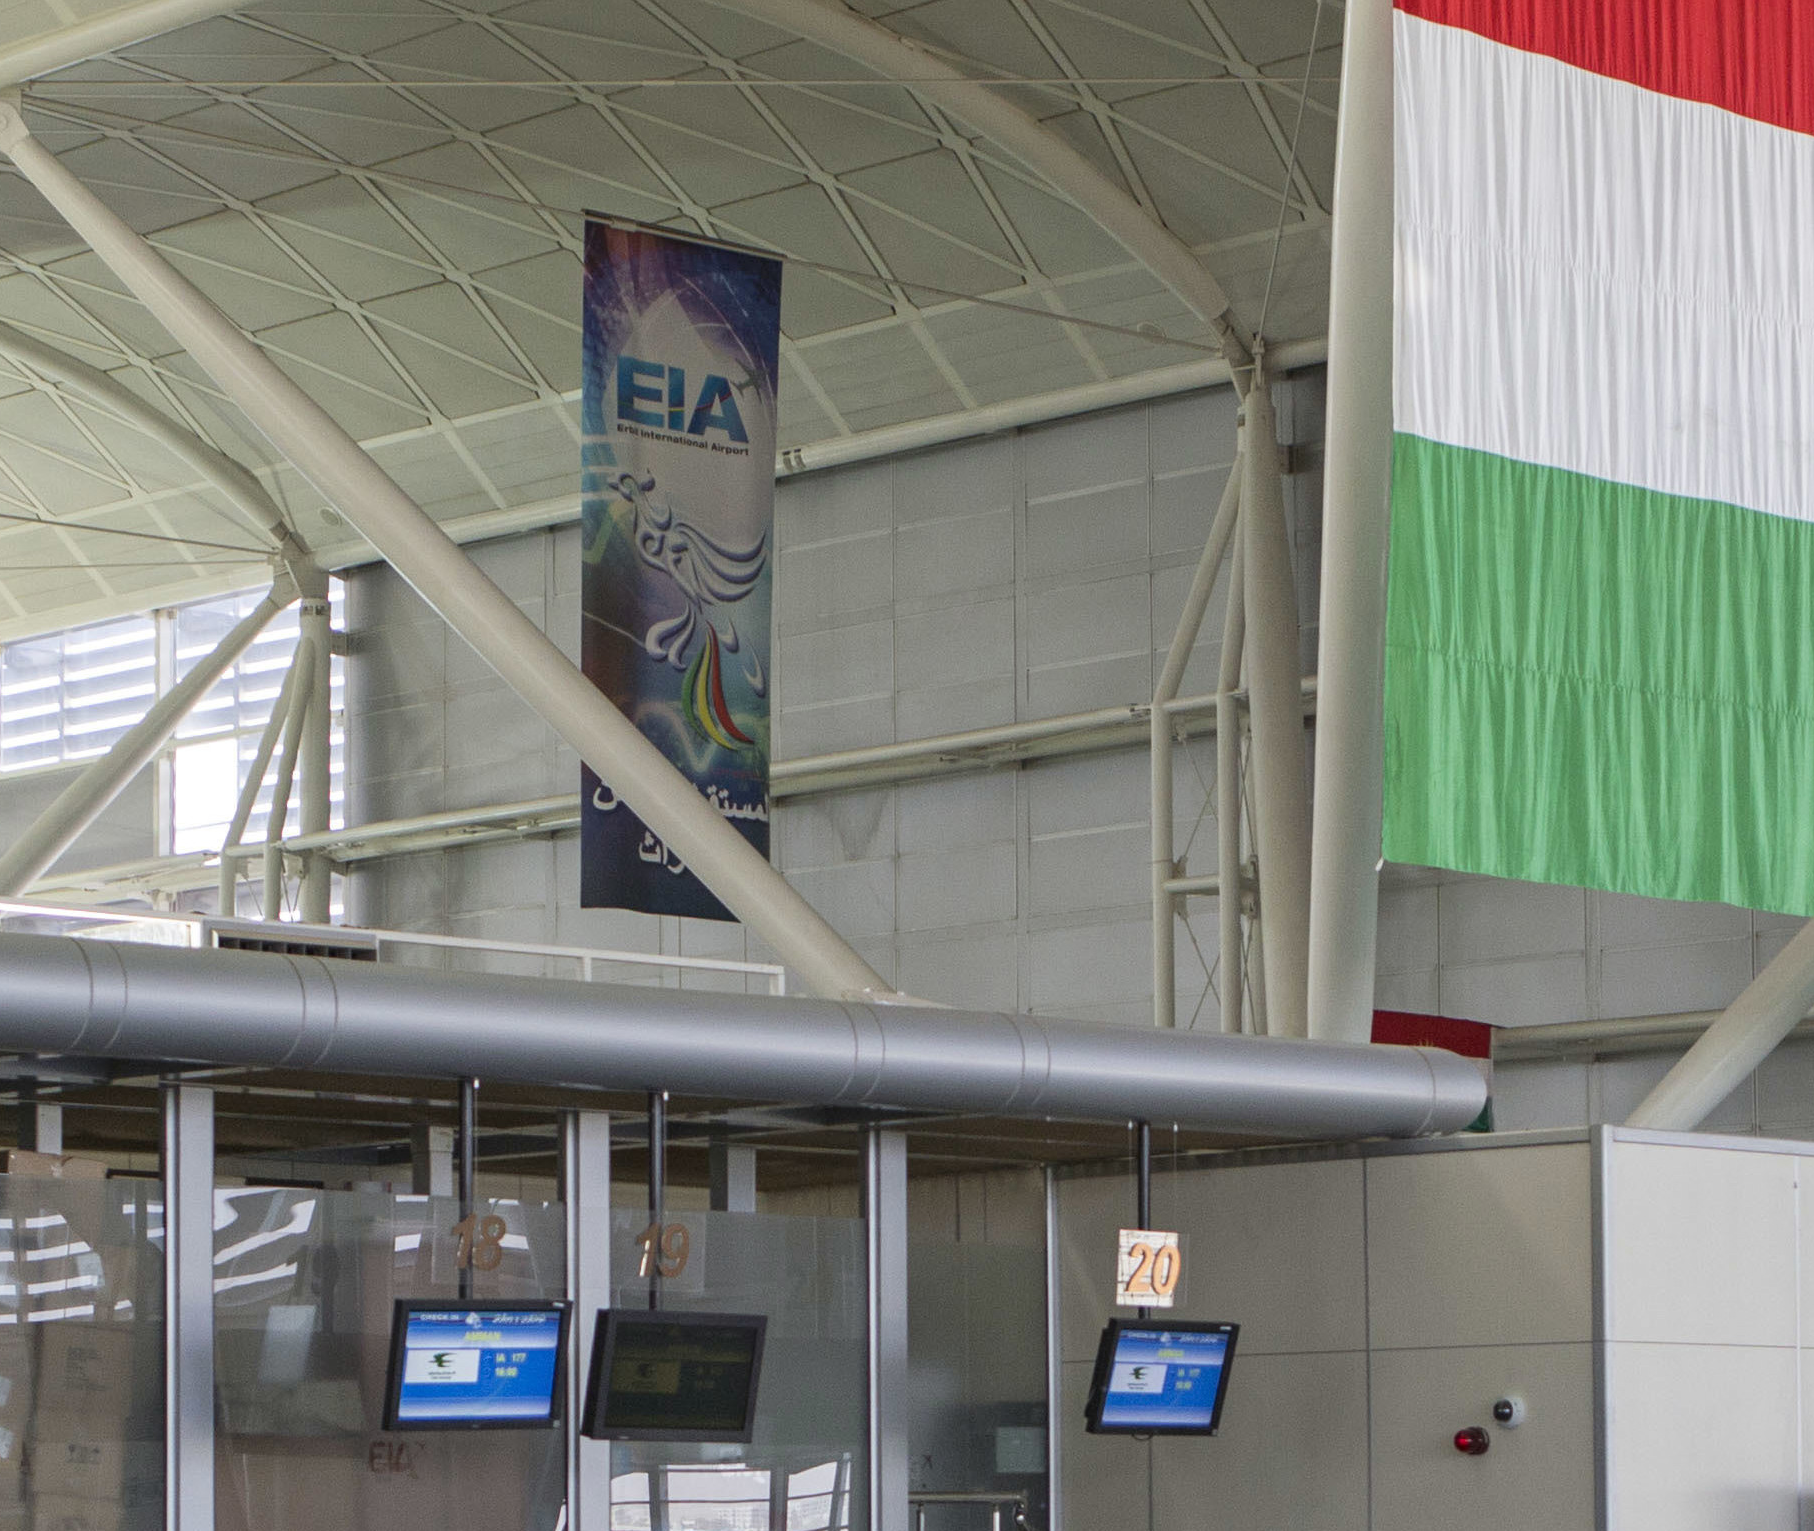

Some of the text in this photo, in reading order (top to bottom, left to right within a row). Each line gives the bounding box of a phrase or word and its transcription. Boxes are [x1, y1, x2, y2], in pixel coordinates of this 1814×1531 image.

[617, 354, 749, 444] EIA
[617, 423, 749, 457] Erbil International Airport
[450, 1213, 506, 1271] 18
[636, 1223, 690, 1278] 19
[1124, 1243, 1182, 1296] 20
